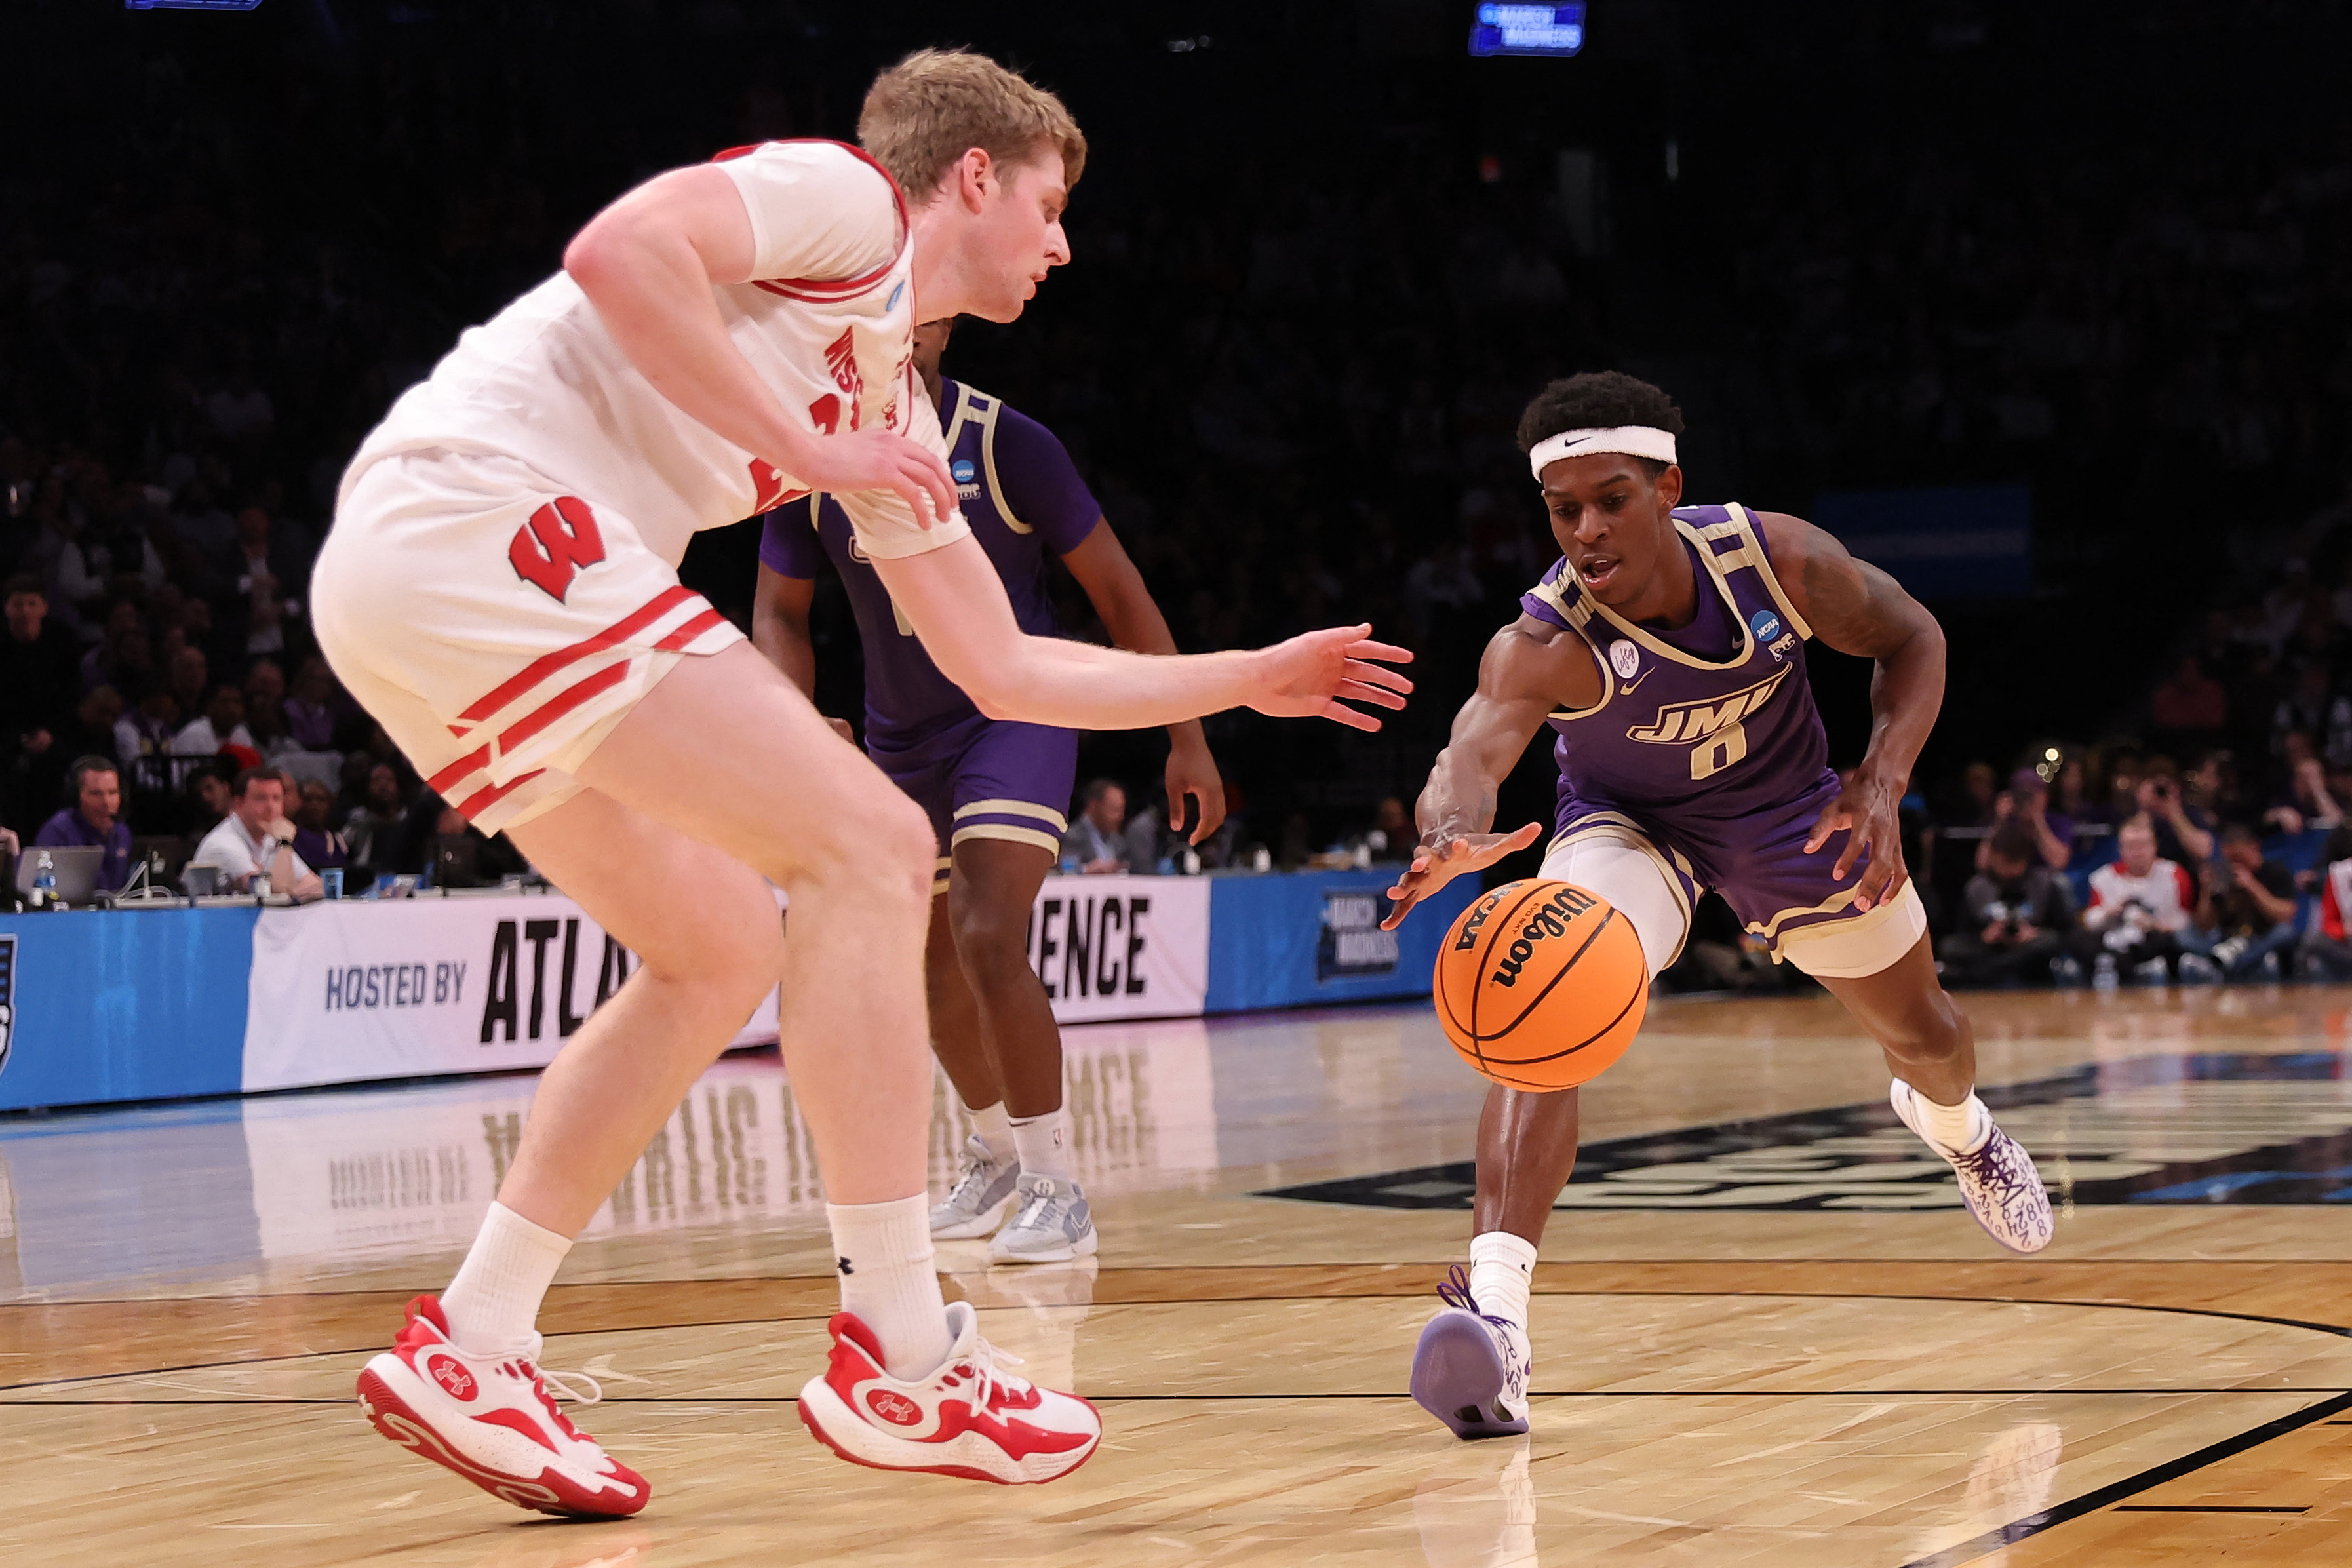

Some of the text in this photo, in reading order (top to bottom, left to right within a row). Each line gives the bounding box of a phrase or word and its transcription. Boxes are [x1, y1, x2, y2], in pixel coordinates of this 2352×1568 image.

[509, 496, 606, 605] W
[1756, 618, 1779, 638] NCAA
[1627, 675, 1780, 744] JMU
[1691, 722, 1747, 781] 0
[1027, 898, 1149, 998] ENCE
[1492, 888, 1598, 988] Wilson
[1512, 902, 1540, 935] EVO NXT
[326, 965, 426, 1010] HOSTED
[435, 960, 466, 1003] BY
